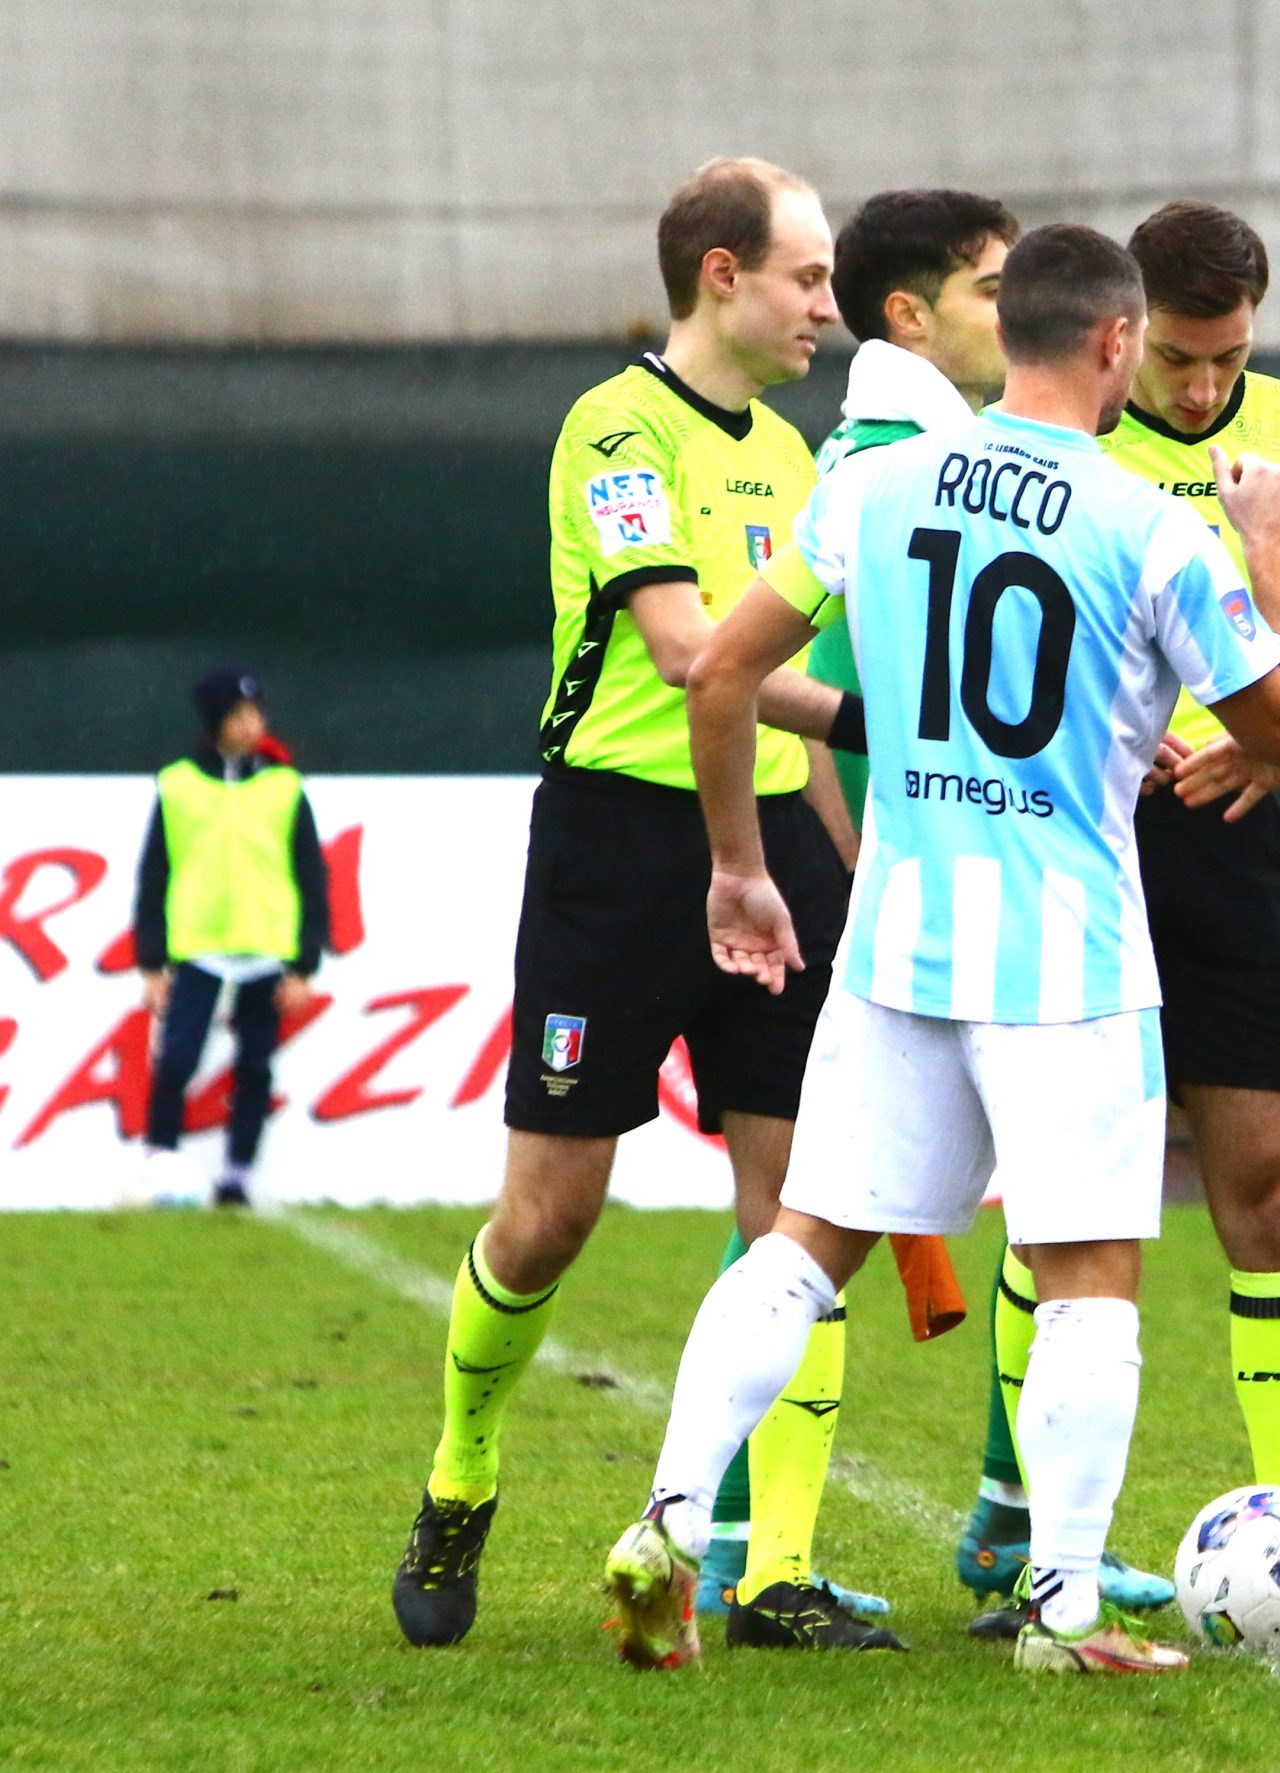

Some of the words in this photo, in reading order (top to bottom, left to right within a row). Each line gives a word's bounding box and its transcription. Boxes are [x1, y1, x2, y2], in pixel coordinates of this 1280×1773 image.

[590, 473, 655, 506] NET
[726, 478, 774, 498] LEGEA
[935, 453, 1072, 536] ROCCO
[907, 527, 1077, 760] 10
